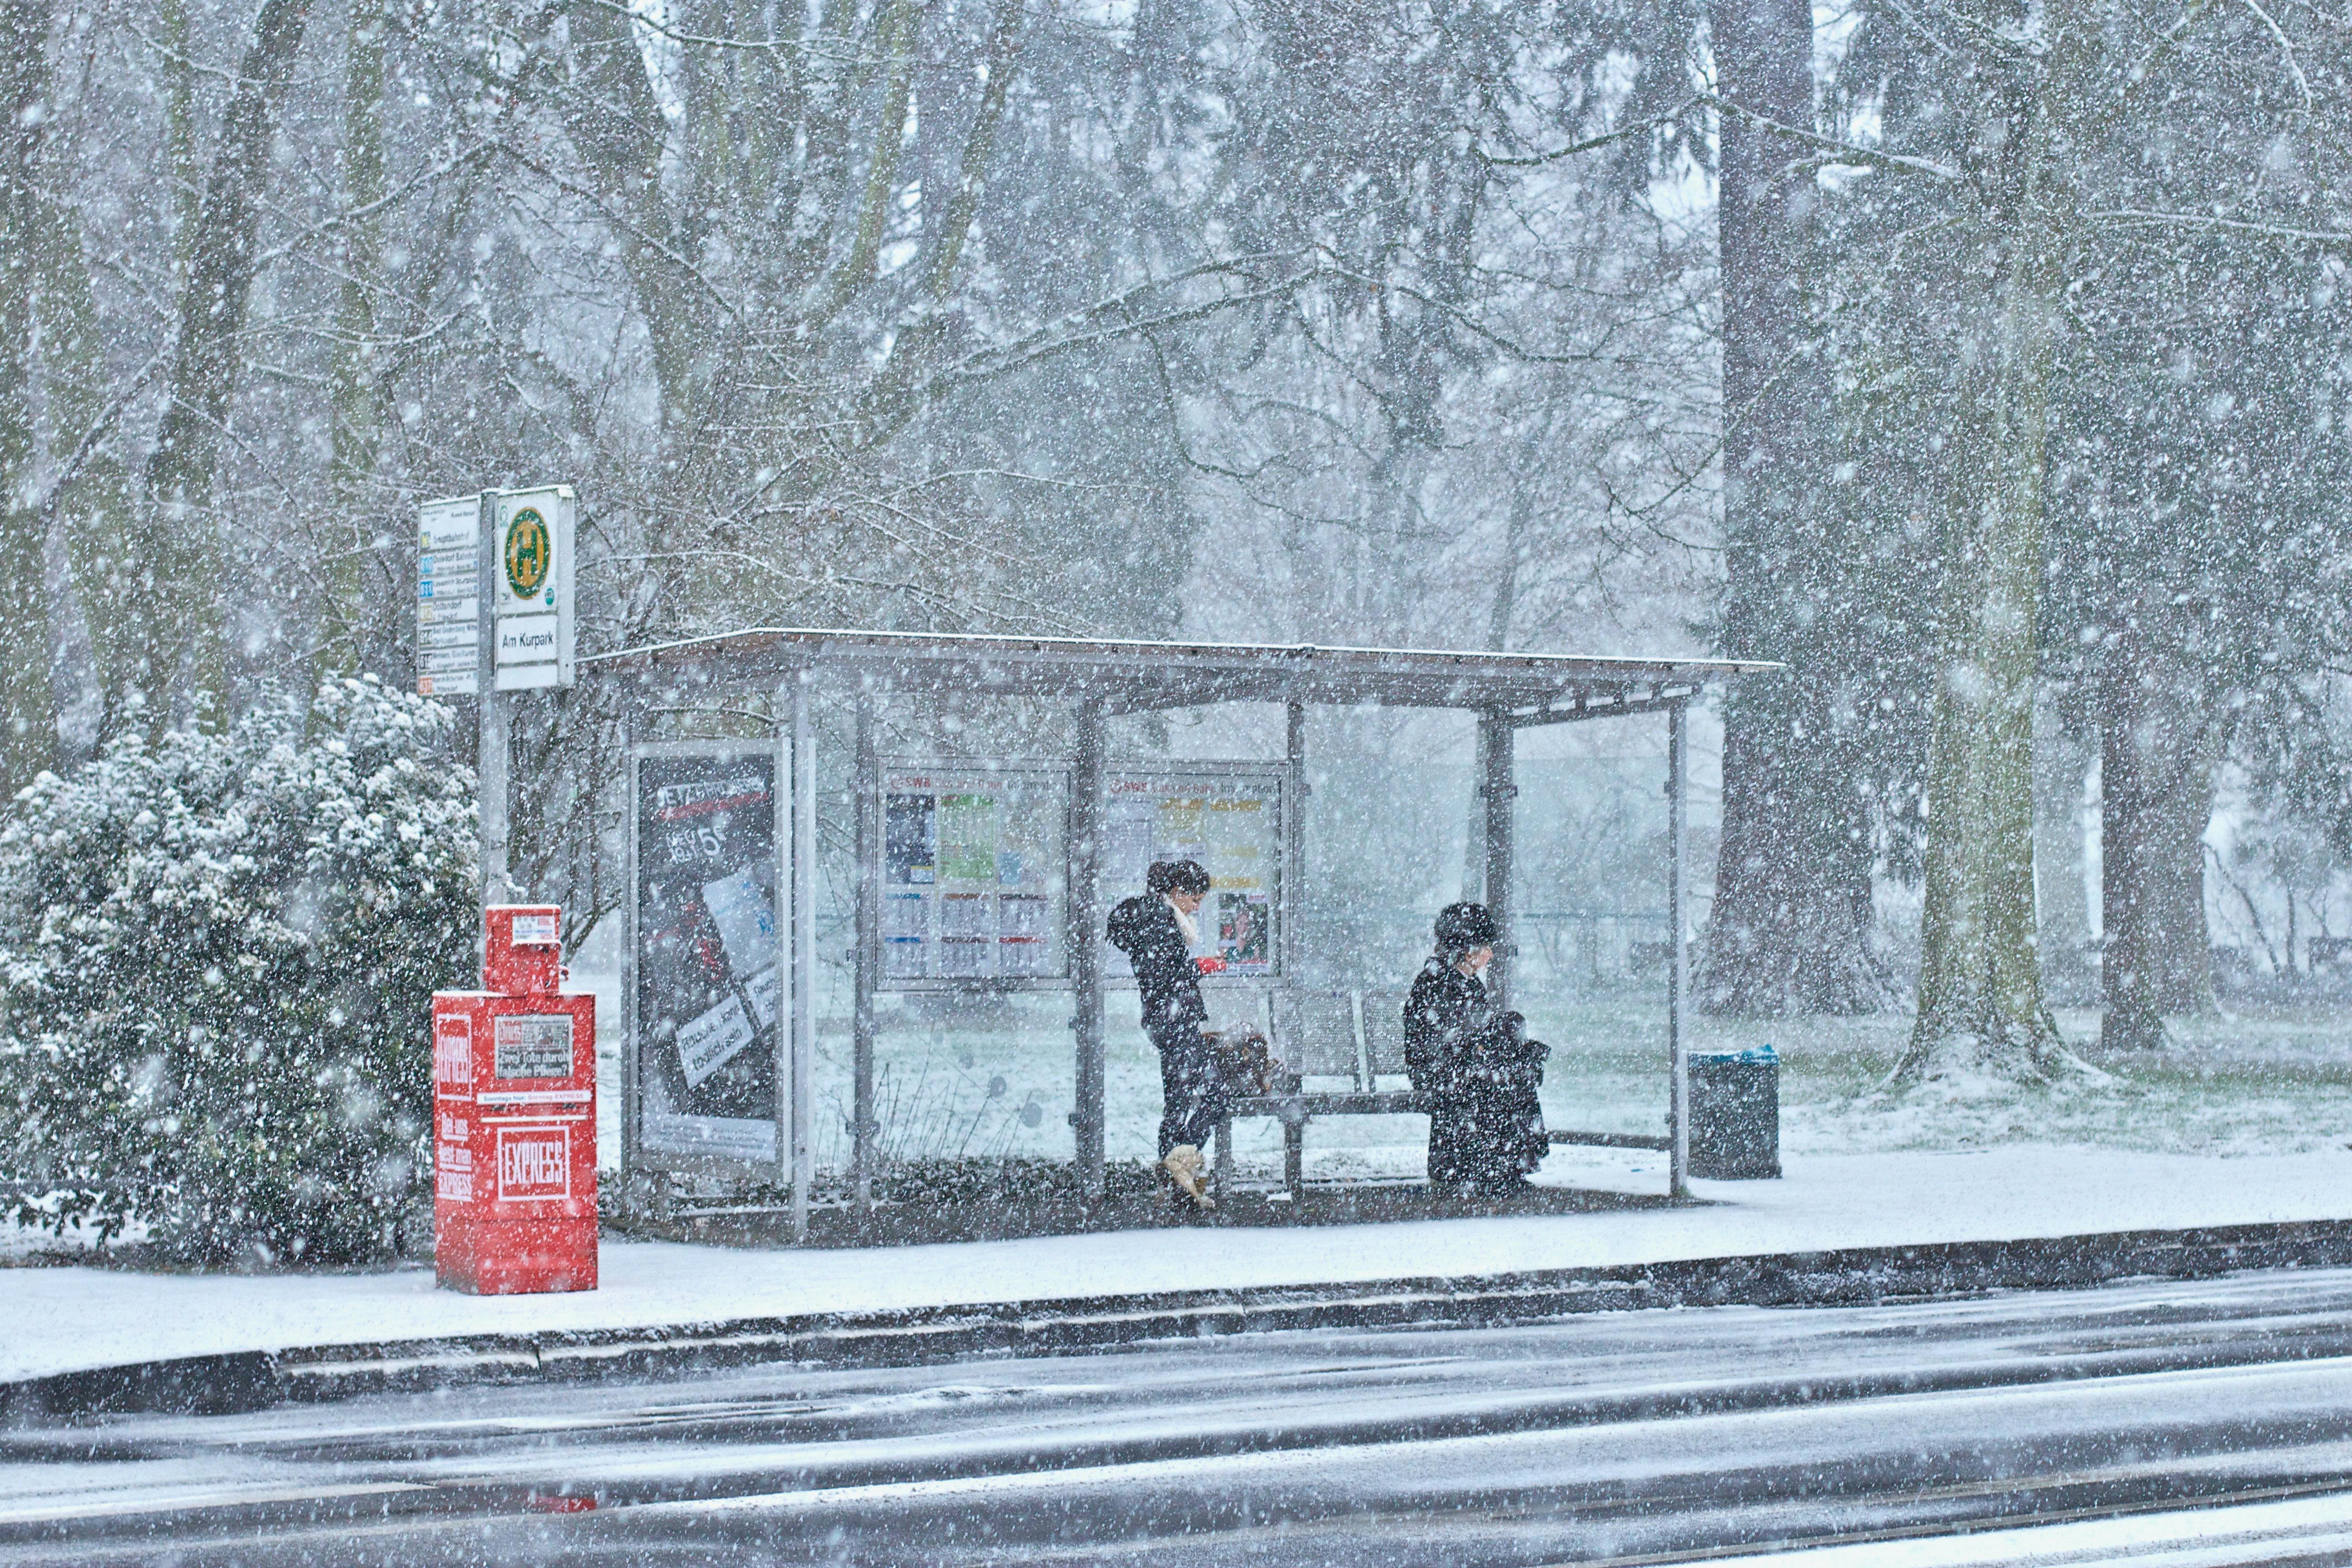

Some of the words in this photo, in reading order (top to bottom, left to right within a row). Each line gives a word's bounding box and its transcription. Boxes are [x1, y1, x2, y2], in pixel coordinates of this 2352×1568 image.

[517, 529, 538, 578] H
[502, 634, 516, 648] Am
[519, 631, 554, 650] Kurpark
[522, 1050, 541, 1064] Tote
[505, 1141, 563, 1185] EXPRESS
